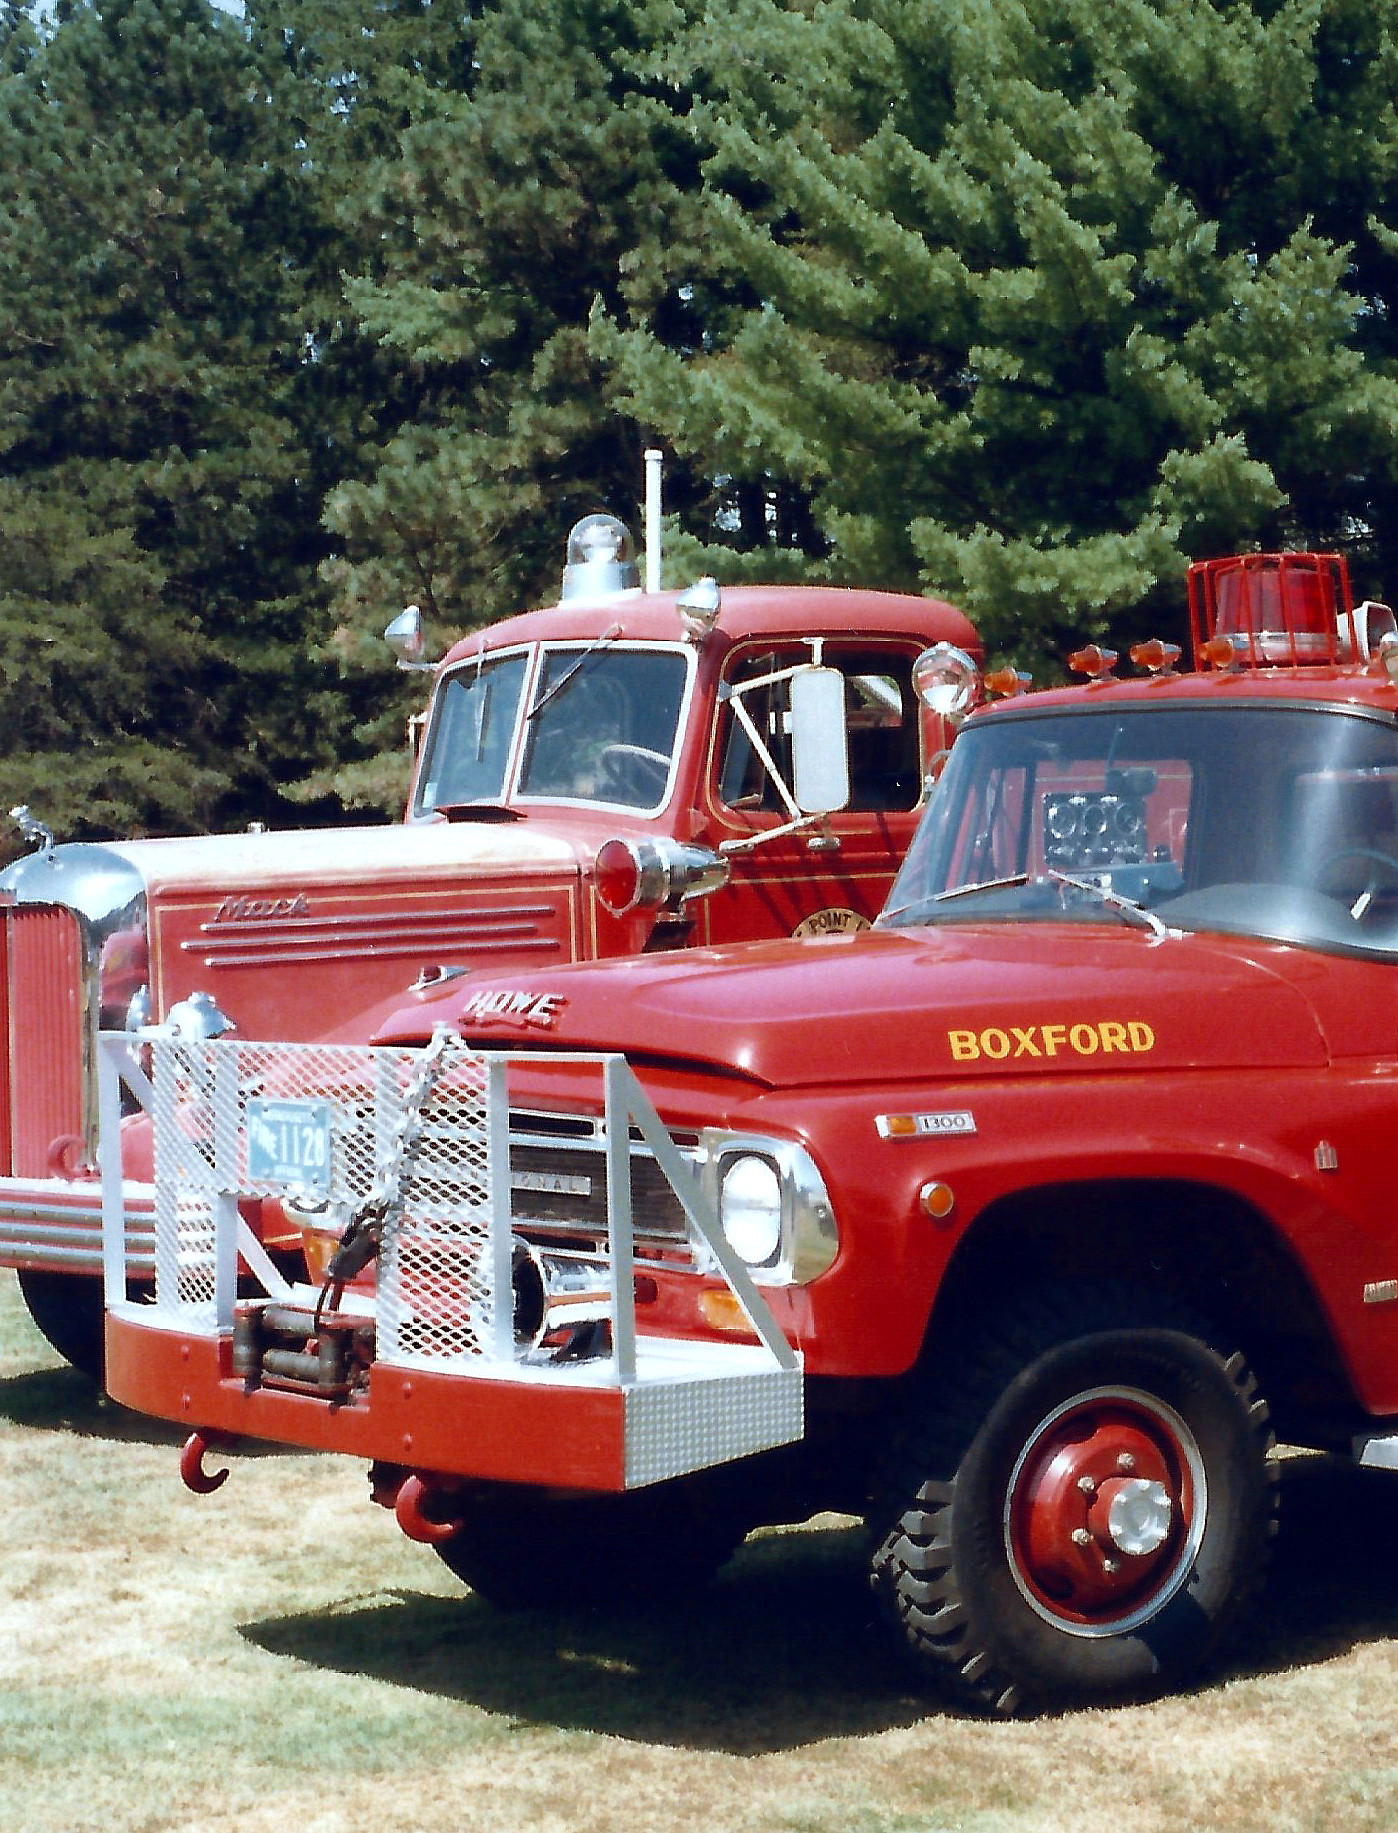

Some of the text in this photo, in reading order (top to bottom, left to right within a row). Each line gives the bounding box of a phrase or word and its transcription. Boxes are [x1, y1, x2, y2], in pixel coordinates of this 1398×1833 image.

[808, 911, 851, 935] POINT
[463, 990, 564, 1017] HOWE
[948, 1021, 1155, 1060] BOXFORD
[924, 1116, 966, 1129] 1300
